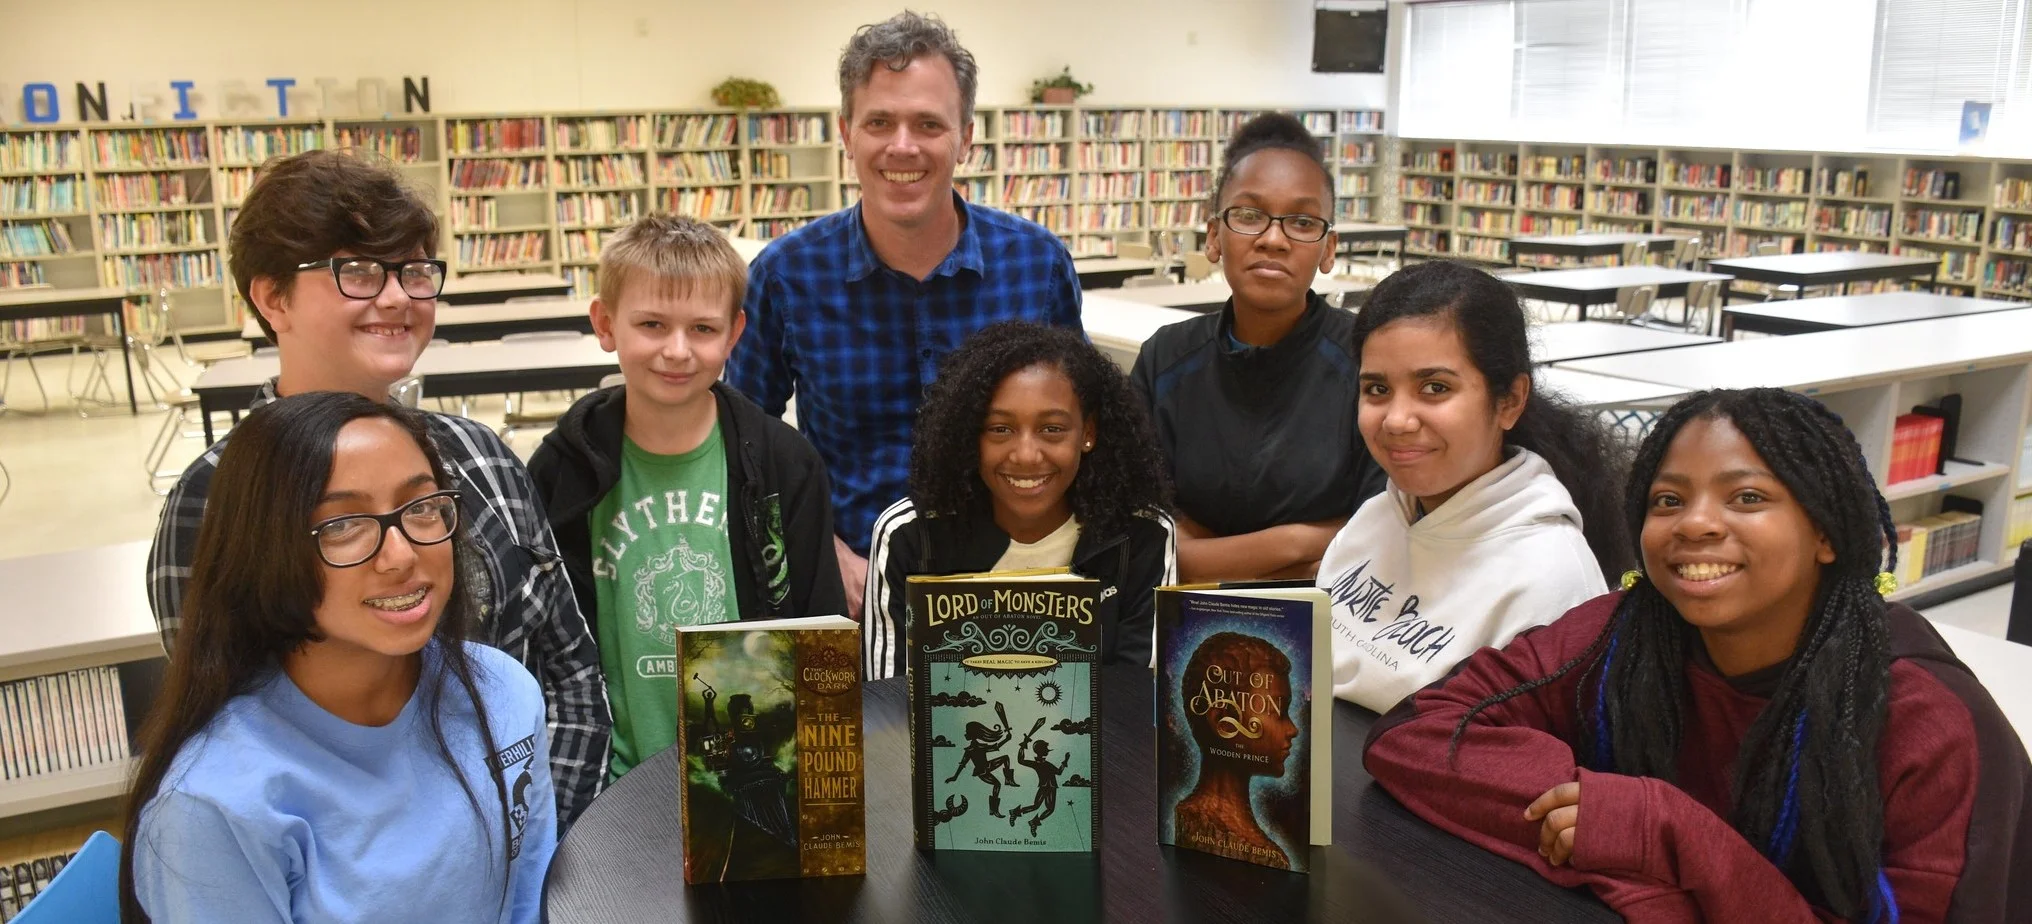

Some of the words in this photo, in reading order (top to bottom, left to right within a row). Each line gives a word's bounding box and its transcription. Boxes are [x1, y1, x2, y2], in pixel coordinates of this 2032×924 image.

[925, 593, 979, 627] LORD
[980, 598, 993, 610] OF
[992, 589, 1094, 626] MONSTERS
[658, 631, 676, 644] SLY
[1331, 618, 1357, 642] UTH
[646, 660, 676, 674] AMB
[803, 667, 857, 684] CLOCKWORK
[1206, 664, 1242, 686] OUT
[1249, 672, 1274, 690] OF
[1190, 680, 1282, 717] ABATON
[817, 712, 840, 722] THE
[804, 725, 856, 747] NINE
[804, 751, 857, 773] POUND
[1209, 746, 1241, 759] WOODEN
[1243, 753, 1270, 764] PRINCE
[804, 776, 857, 799] HAMMER
[803, 842, 833, 851] CLAUDE
[835, 840, 861, 849] BEMIS
[820, 834, 841, 842] JOHN
[974, 837, 994, 845] John
[995, 837, 1022, 846] Claude
[1023, 838, 1047, 846] Bemis
[1191, 831, 1216, 846] JOHN
[1217, 839, 1250, 853] CLAUDE
[1252, 845, 1277, 858] BEMIS
